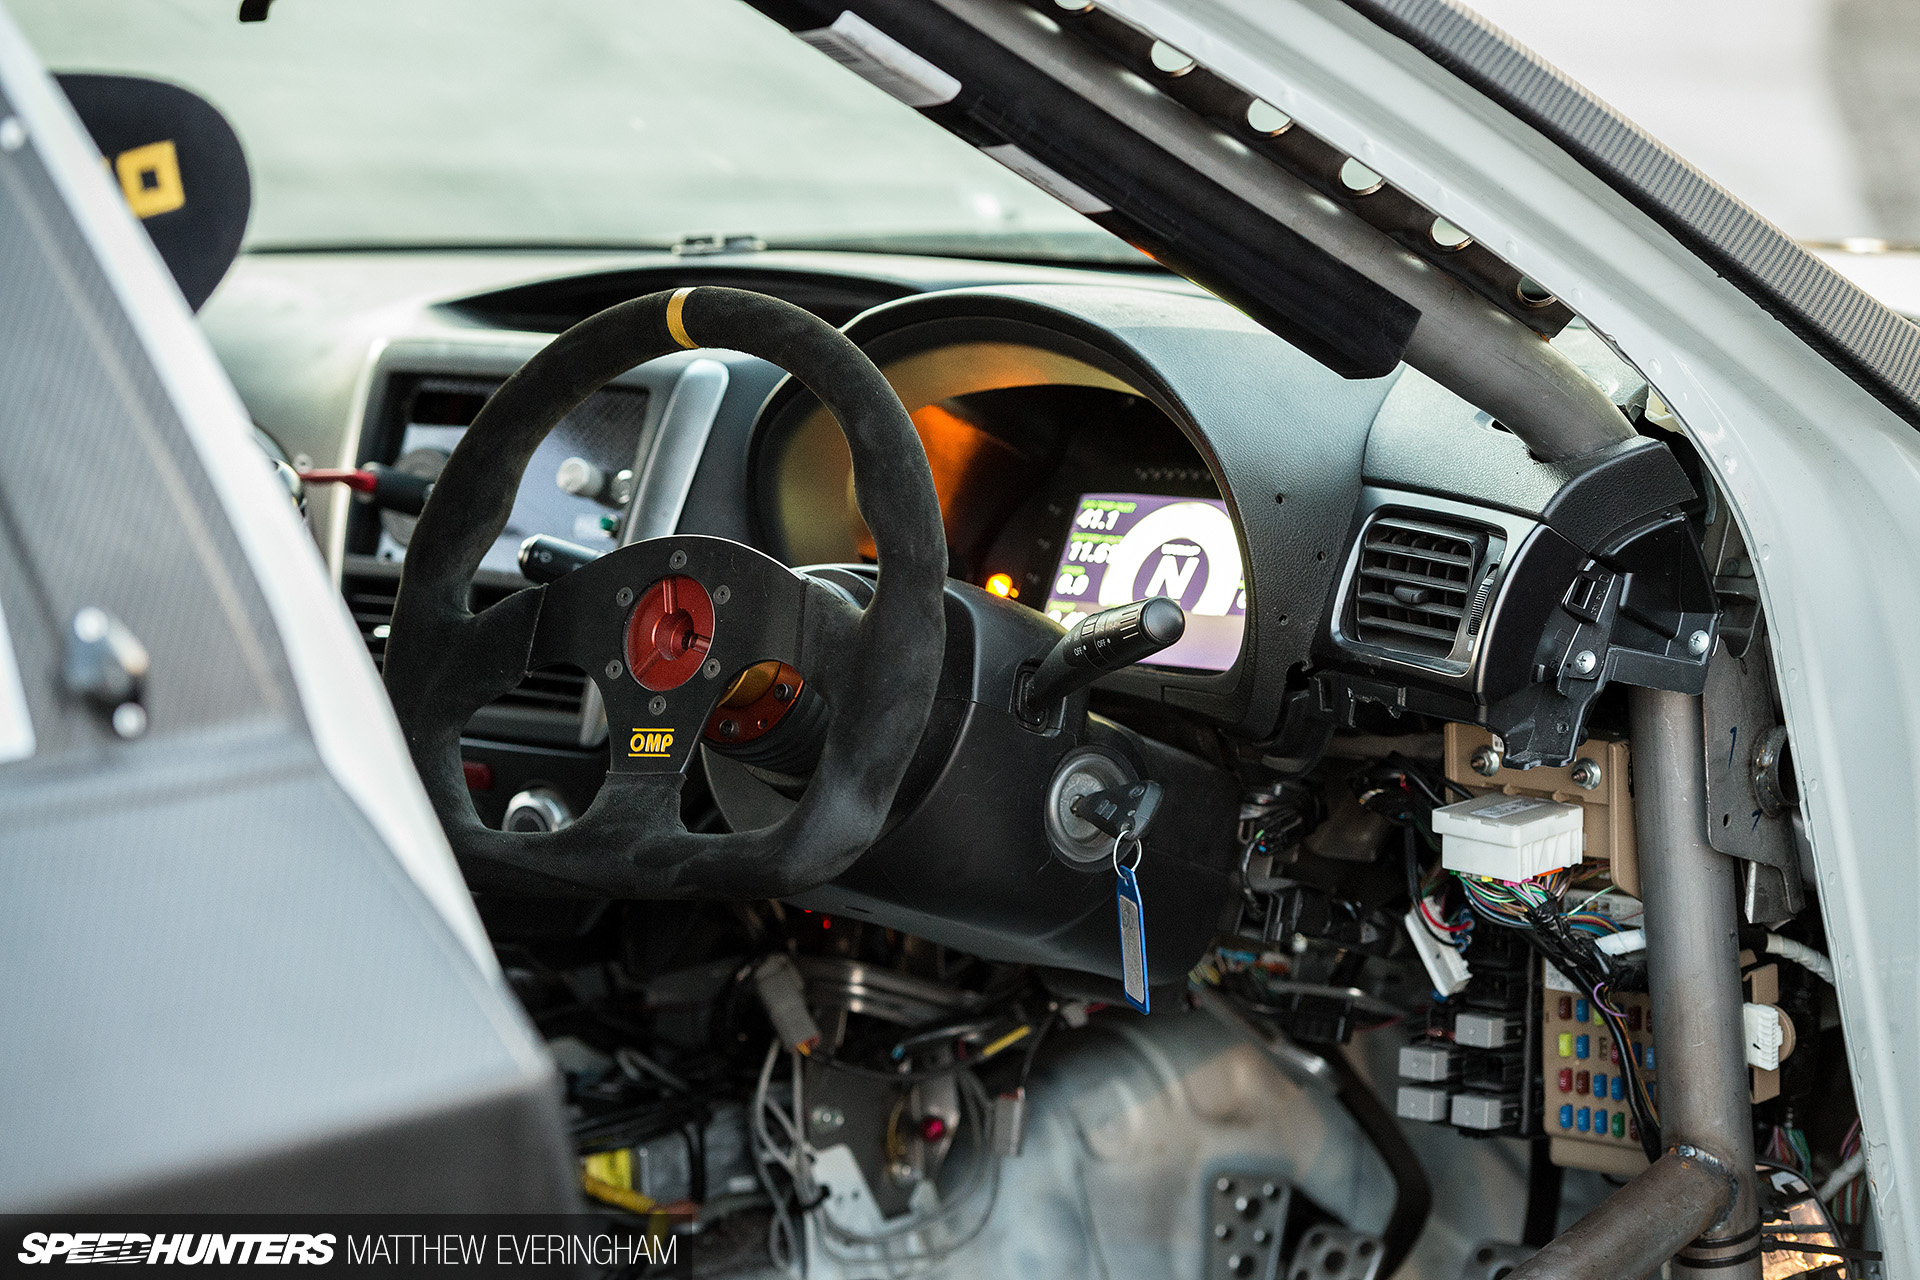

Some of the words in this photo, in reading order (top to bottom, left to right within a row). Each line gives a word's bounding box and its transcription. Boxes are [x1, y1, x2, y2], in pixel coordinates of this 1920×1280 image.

[1144, 554, 1200, 600] N
[1096, 639, 1107, 648] OFF
[1073, 647, 1083, 657] OFF
[630, 733, 674, 752] OMP
